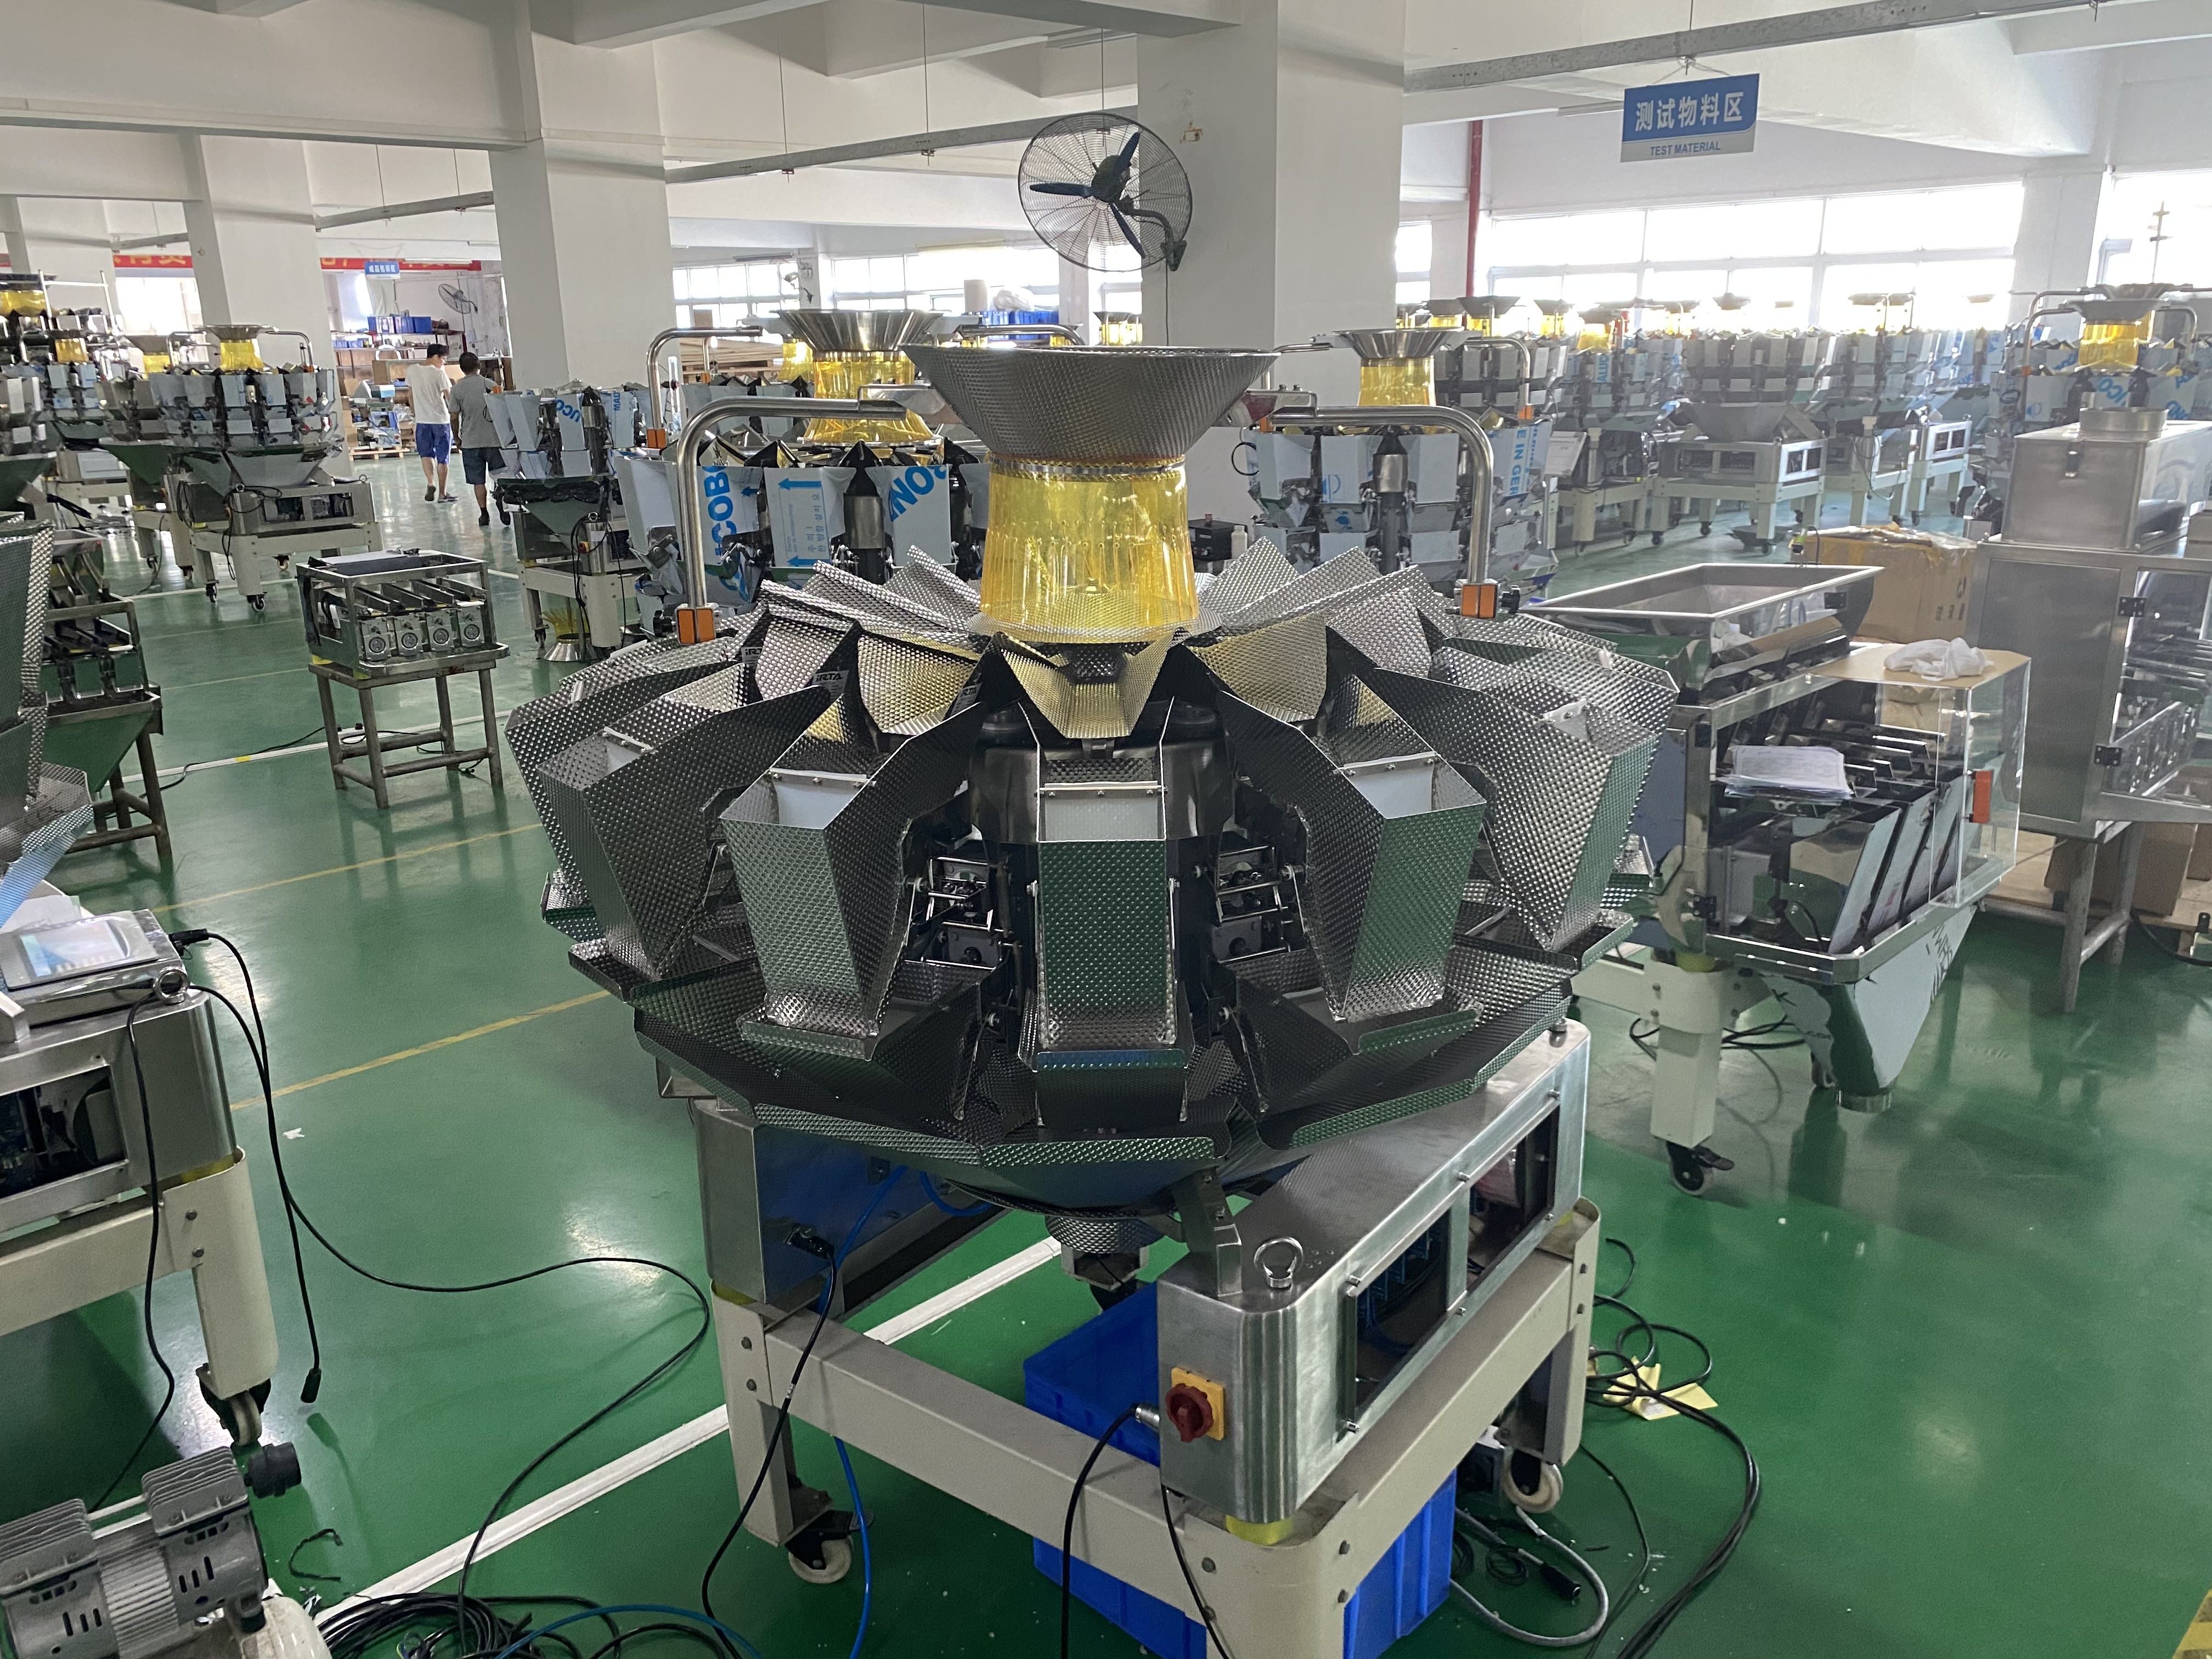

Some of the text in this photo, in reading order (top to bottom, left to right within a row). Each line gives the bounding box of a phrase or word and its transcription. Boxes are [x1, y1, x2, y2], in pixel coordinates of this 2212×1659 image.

[1635, 92, 1744, 132] 测试物料区
[1650, 141, 1721, 156] TEST MATERIAL
[702, 466, 737, 556] COB
